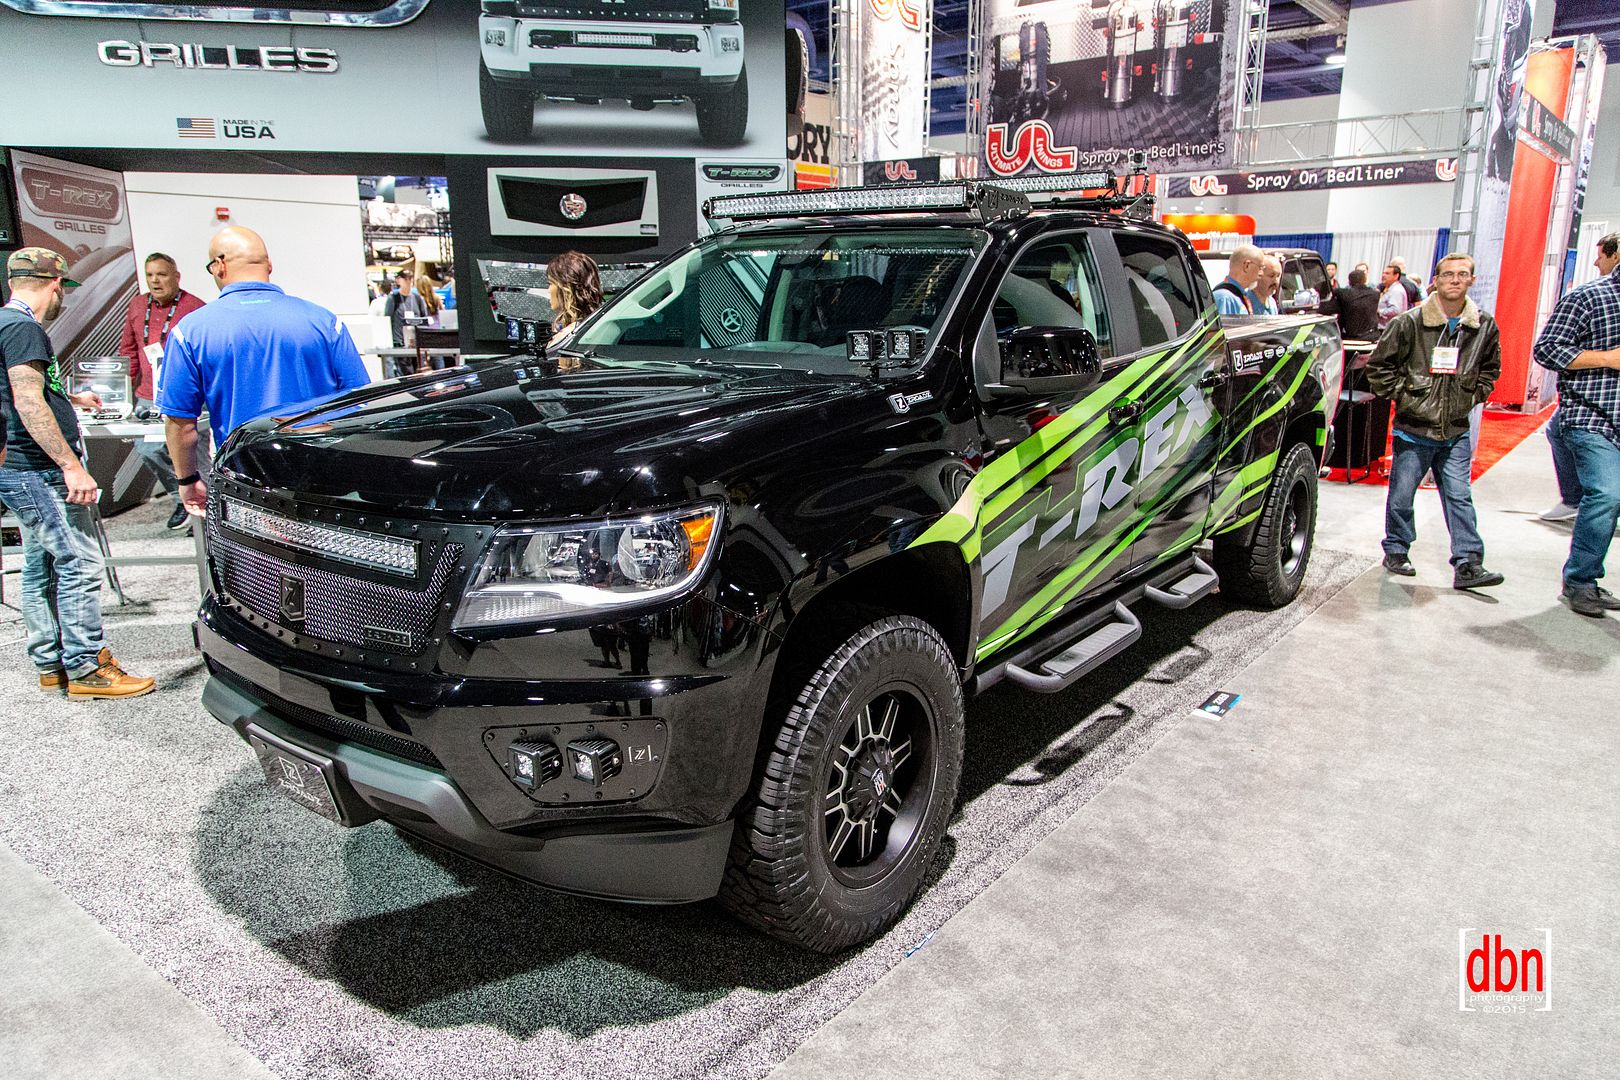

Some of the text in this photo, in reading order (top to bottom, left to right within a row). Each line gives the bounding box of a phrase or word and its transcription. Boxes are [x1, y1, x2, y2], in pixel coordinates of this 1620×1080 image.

[97, 40, 340, 73] GRILLES
[223, 125, 275, 139] USA
[990, 142, 1023, 171] ULTIMATE
[1036, 137, 1063, 167] LININGS
[1082, 151, 1120, 166] Spray
[1151, 142, 1225, 159] Bedliners
[708, 167, 776, 178] T-REX
[1247, 166, 1404, 190] Spray On Bedliner
[31, 178, 113, 210] T-REX
[54, 220, 107, 235] GRILLES
[980, 360, 1214, 622] T-REX
